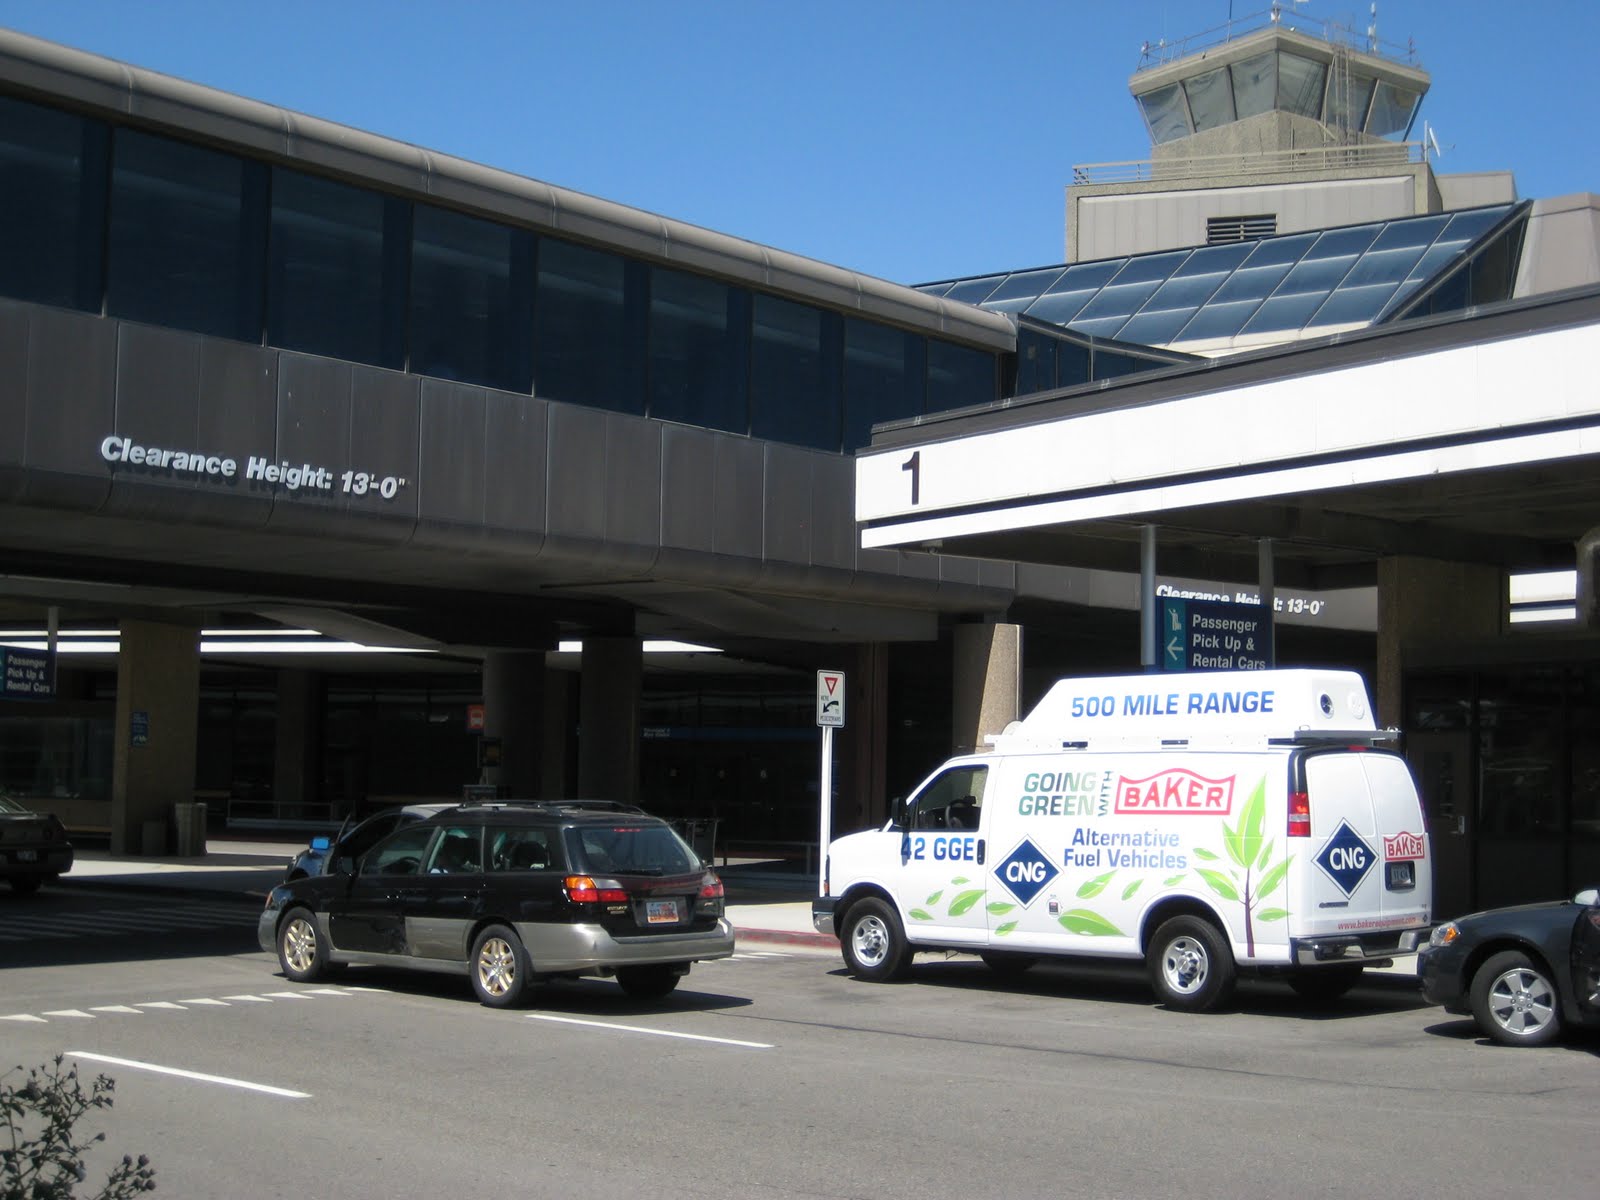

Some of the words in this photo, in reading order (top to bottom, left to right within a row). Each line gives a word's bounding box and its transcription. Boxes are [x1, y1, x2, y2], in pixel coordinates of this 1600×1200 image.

[101, 436, 237, 476] Clearance
[246, 456, 333, 489] Height:
[901, 450, 920, 506] 1
[1192, 614, 1258, 633] Passenger
[1192, 634, 1220, 649] Pick
[1225, 636, 1241, 652] Up
[1246, 638, 1255, 651] &
[7, 655, 47, 669] Passenger
[1192, 654, 1233, 668] Rental
[1237, 656, 1266, 671] Cars
[7, 667, 23, 680] Pick
[26, 669, 37, 681] Up
[38, 670, 44, 680] &
[6, 680, 31, 692] Rental
[33, 682, 50, 693] Cars
[1071, 696, 1116, 718] 500
[1122, 693, 1180, 716] MILE
[1187, 690, 1275, 714] RANGE
[1024, 772, 1097, 793] GOING
[1123, 776, 1225, 808] BAKER
[1097, 771, 1114, 817] WITH
[1018, 795, 1096, 816] GREEN
[1071, 828, 1180, 847] Alternative
[1387, 835, 1423, 858] BAKER
[933, 837, 975, 861] GGE
[1063, 848, 1101, 868] Fuel
[1107, 849, 1188, 869] Vehicles
[1329, 846, 1366, 871] CNG
[1006, 861, 1047, 883] CNG
